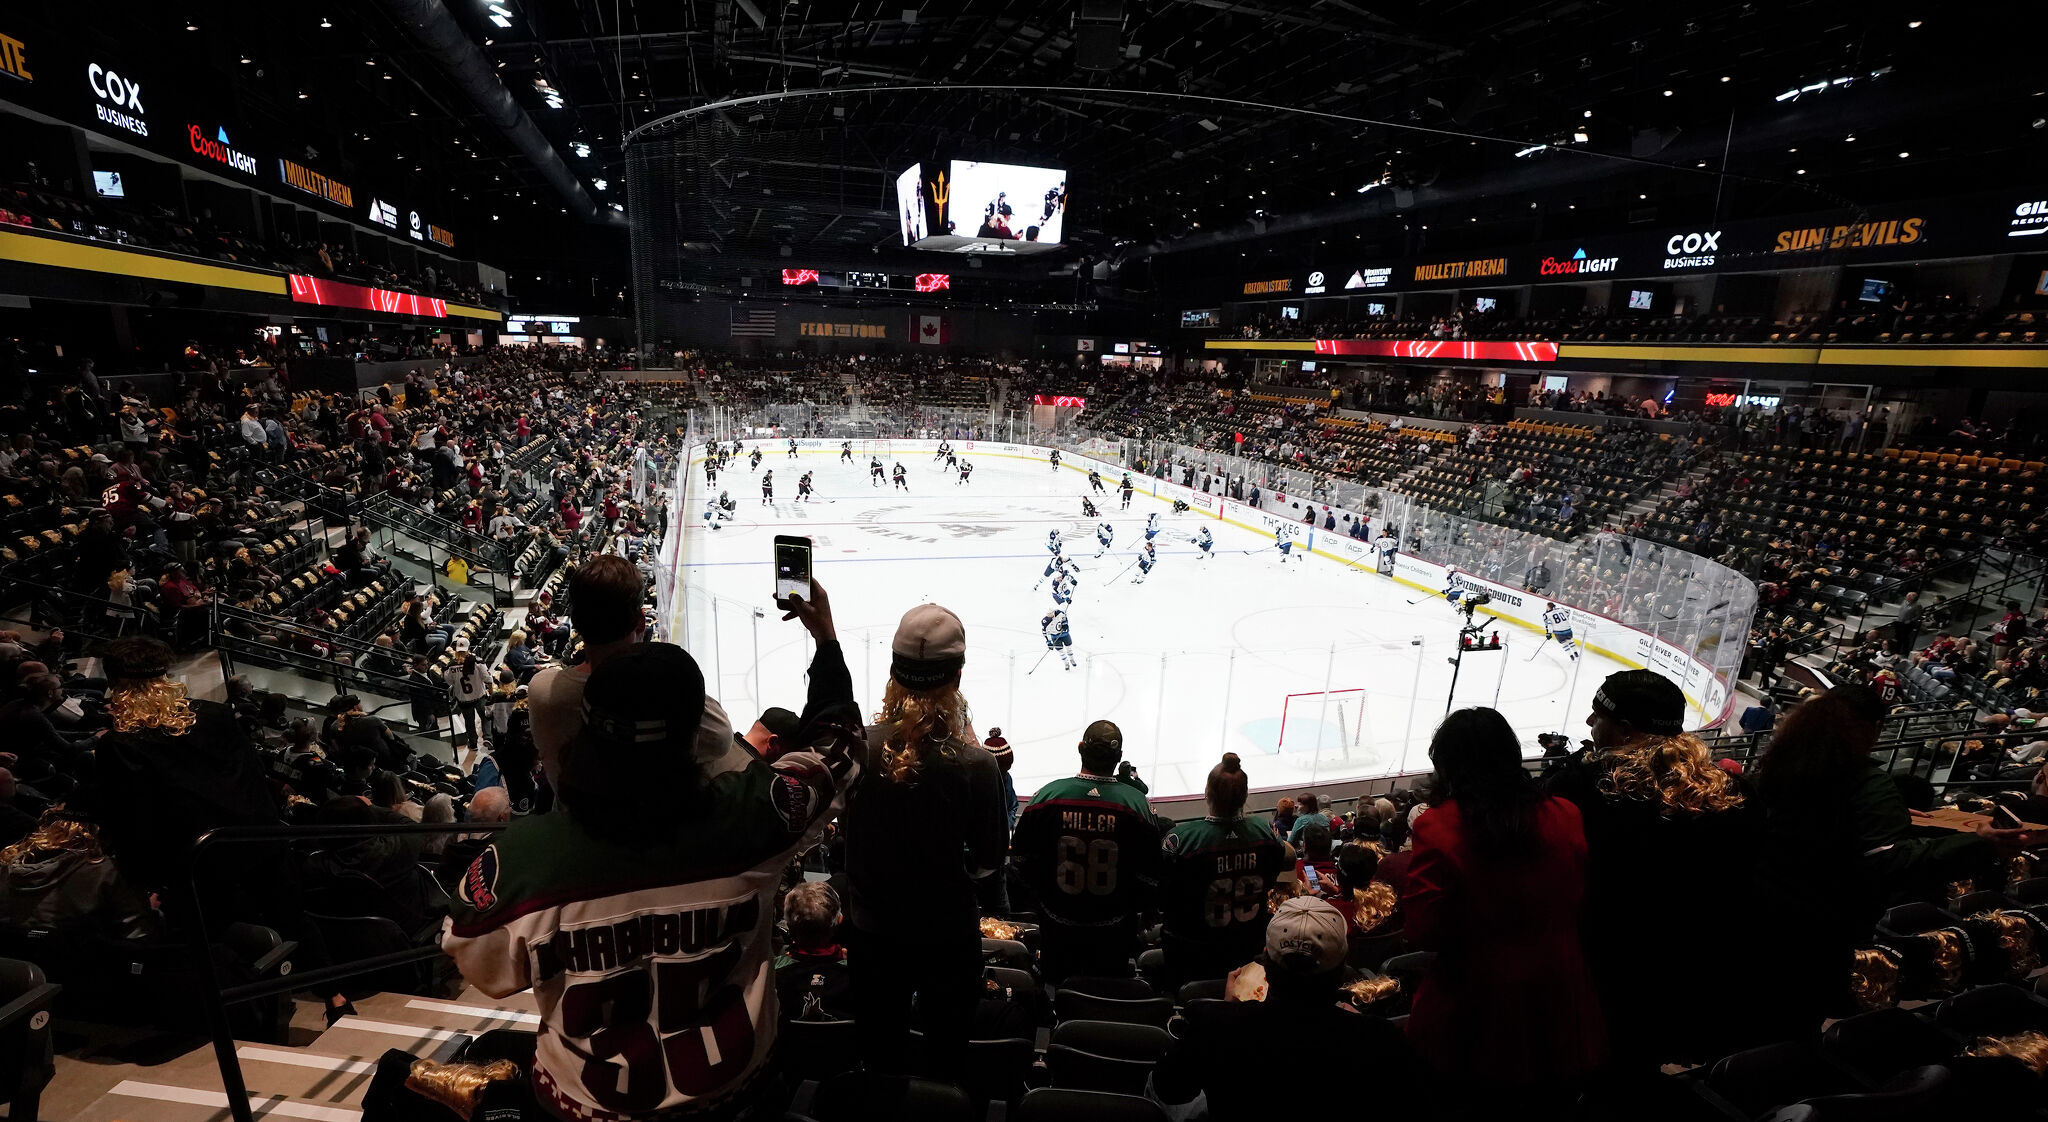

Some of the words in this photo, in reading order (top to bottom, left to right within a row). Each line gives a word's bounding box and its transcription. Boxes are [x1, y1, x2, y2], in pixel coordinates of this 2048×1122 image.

[0, 32, 33, 80] TE
[88, 63, 144, 114] COX
[96, 103, 148, 137] BUSINESS
[187, 123, 227, 164] Coors
[226, 147, 257, 175] LIGHT
[285, 159, 327, 198] MULLETT
[328, 178, 354, 208] ARENA
[1667, 231, 1721, 255] COX
[1774, 226, 1825, 253] SUN
[1831, 218, 1925, 249] DEVILS
[1414, 261, 1465, 281] MULLETT
[1465, 258, 1505, 277] ARENA
[1540, 256, 1588, 275] Coors
[1588, 257, 1629, 274] LIGHT
[1664, 255, 1715, 269] BUSINESS
[1243, 281, 1269, 295] ARIZONA
[800, 322, 834, 337] FEAR
[852, 324, 886, 338] FORK
[102, 487, 119, 507] 35
[1282, 519, 1300, 536] KEG
[1487, 587, 1523, 607] COYOTES
[1552, 612, 1567, 624] 80
[1654, 645, 1672, 658] RIVER
[1673, 655, 1686, 667] GILA
[460, 675, 473, 694] 6
[1881, 686, 1896, 701] 19
[1062, 811, 1116, 833] MILLER
[1056, 835, 1119, 896] 68
[1216, 852, 1257, 874] BLAIR
[1279, 939, 1294, 950] LOS
